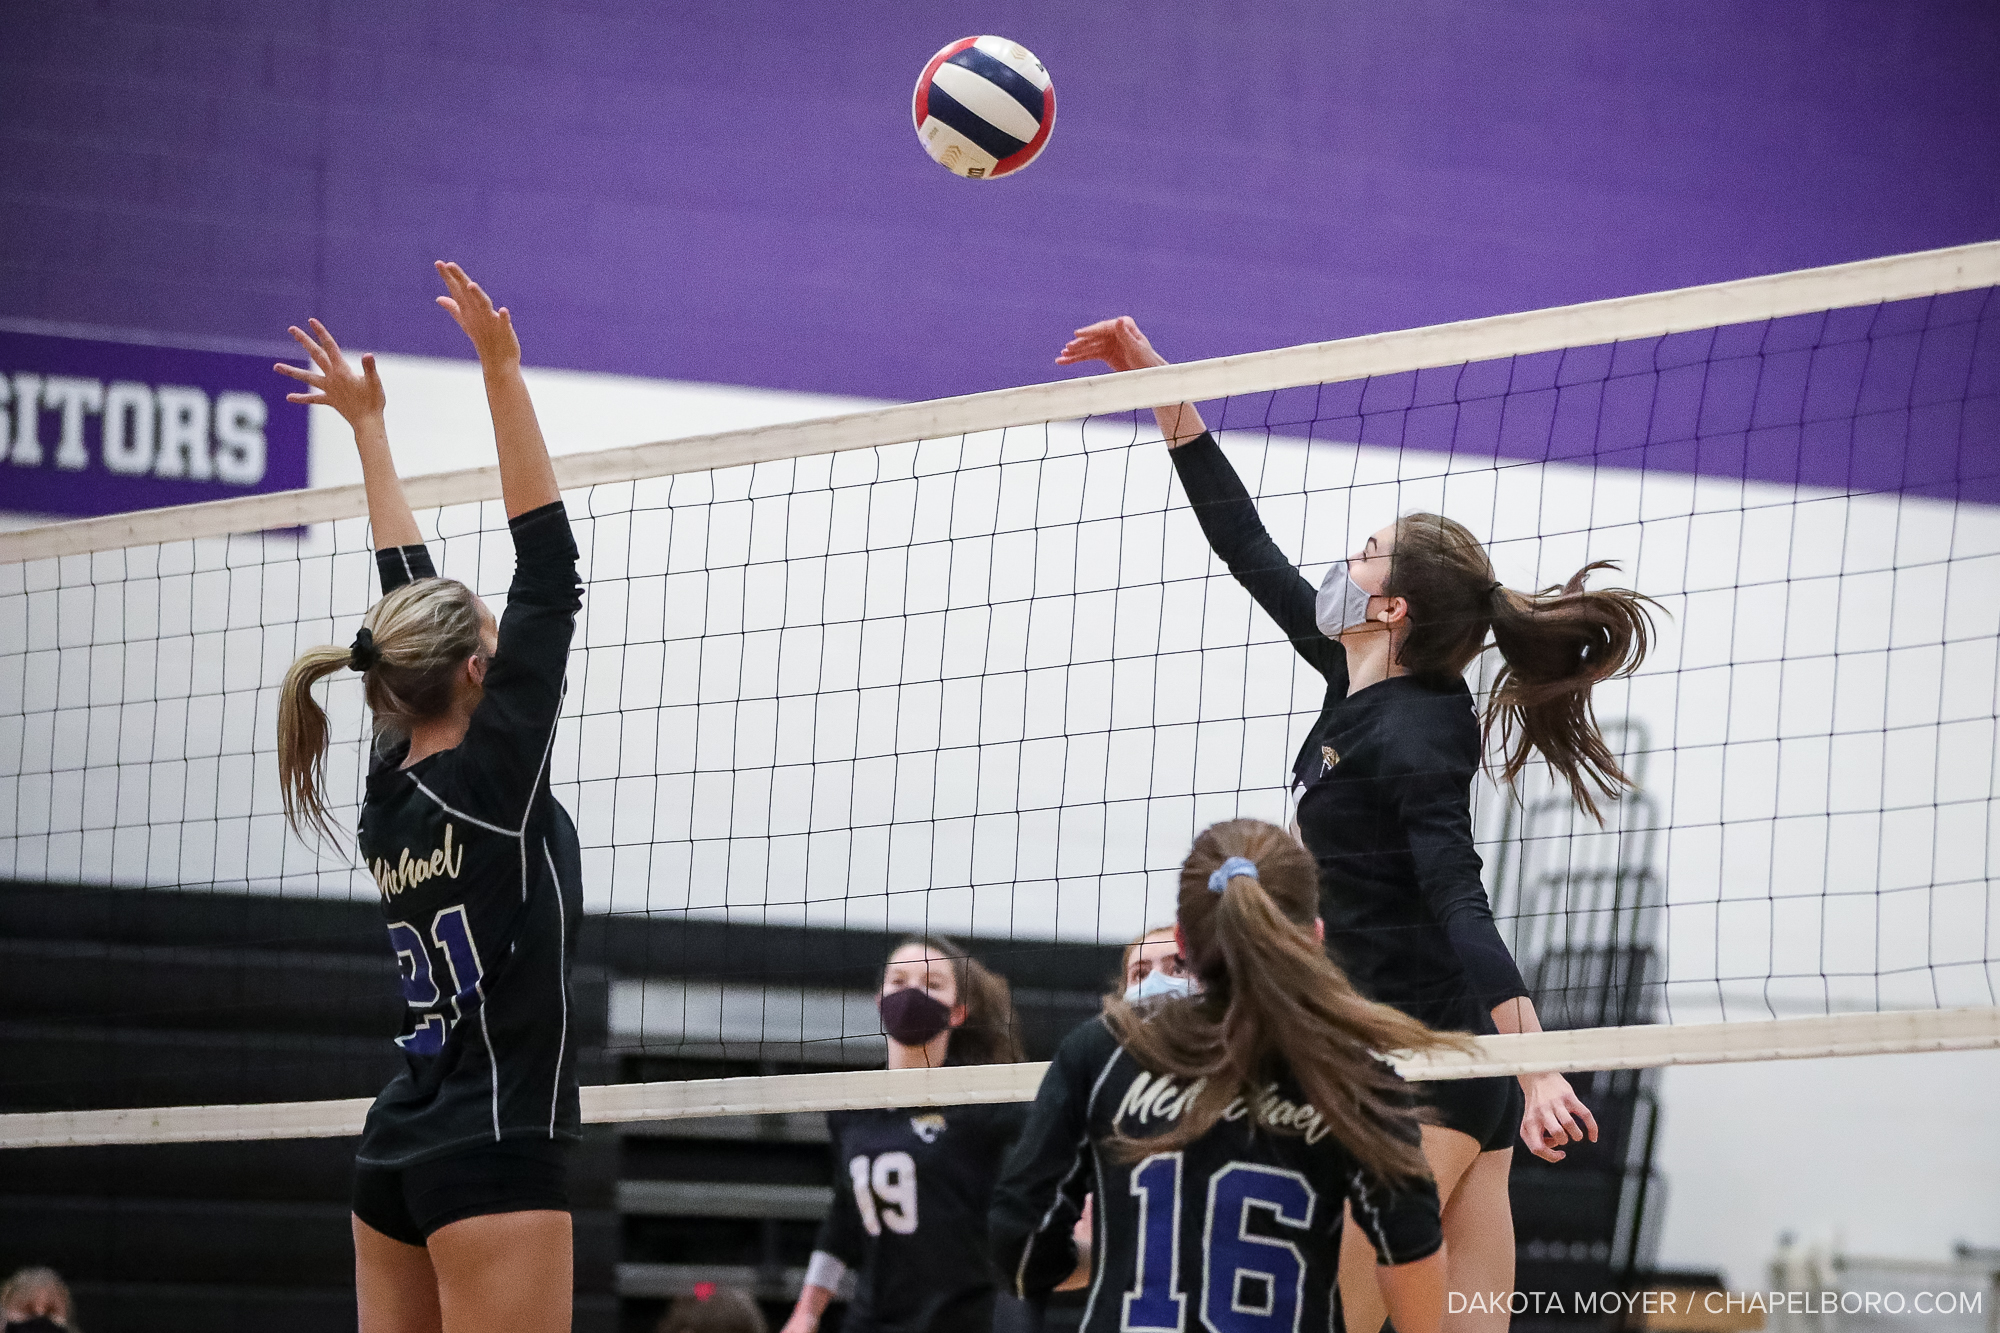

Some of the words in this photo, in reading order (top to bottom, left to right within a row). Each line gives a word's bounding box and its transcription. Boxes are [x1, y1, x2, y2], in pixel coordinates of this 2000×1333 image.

[0, 371, 267, 486] ITORS
[365, 823, 463, 904] Michael
[387, 903, 486, 1056] 21
[850, 1151, 918, 1236] 19
[1120, 1150, 1317, 1333] 16
